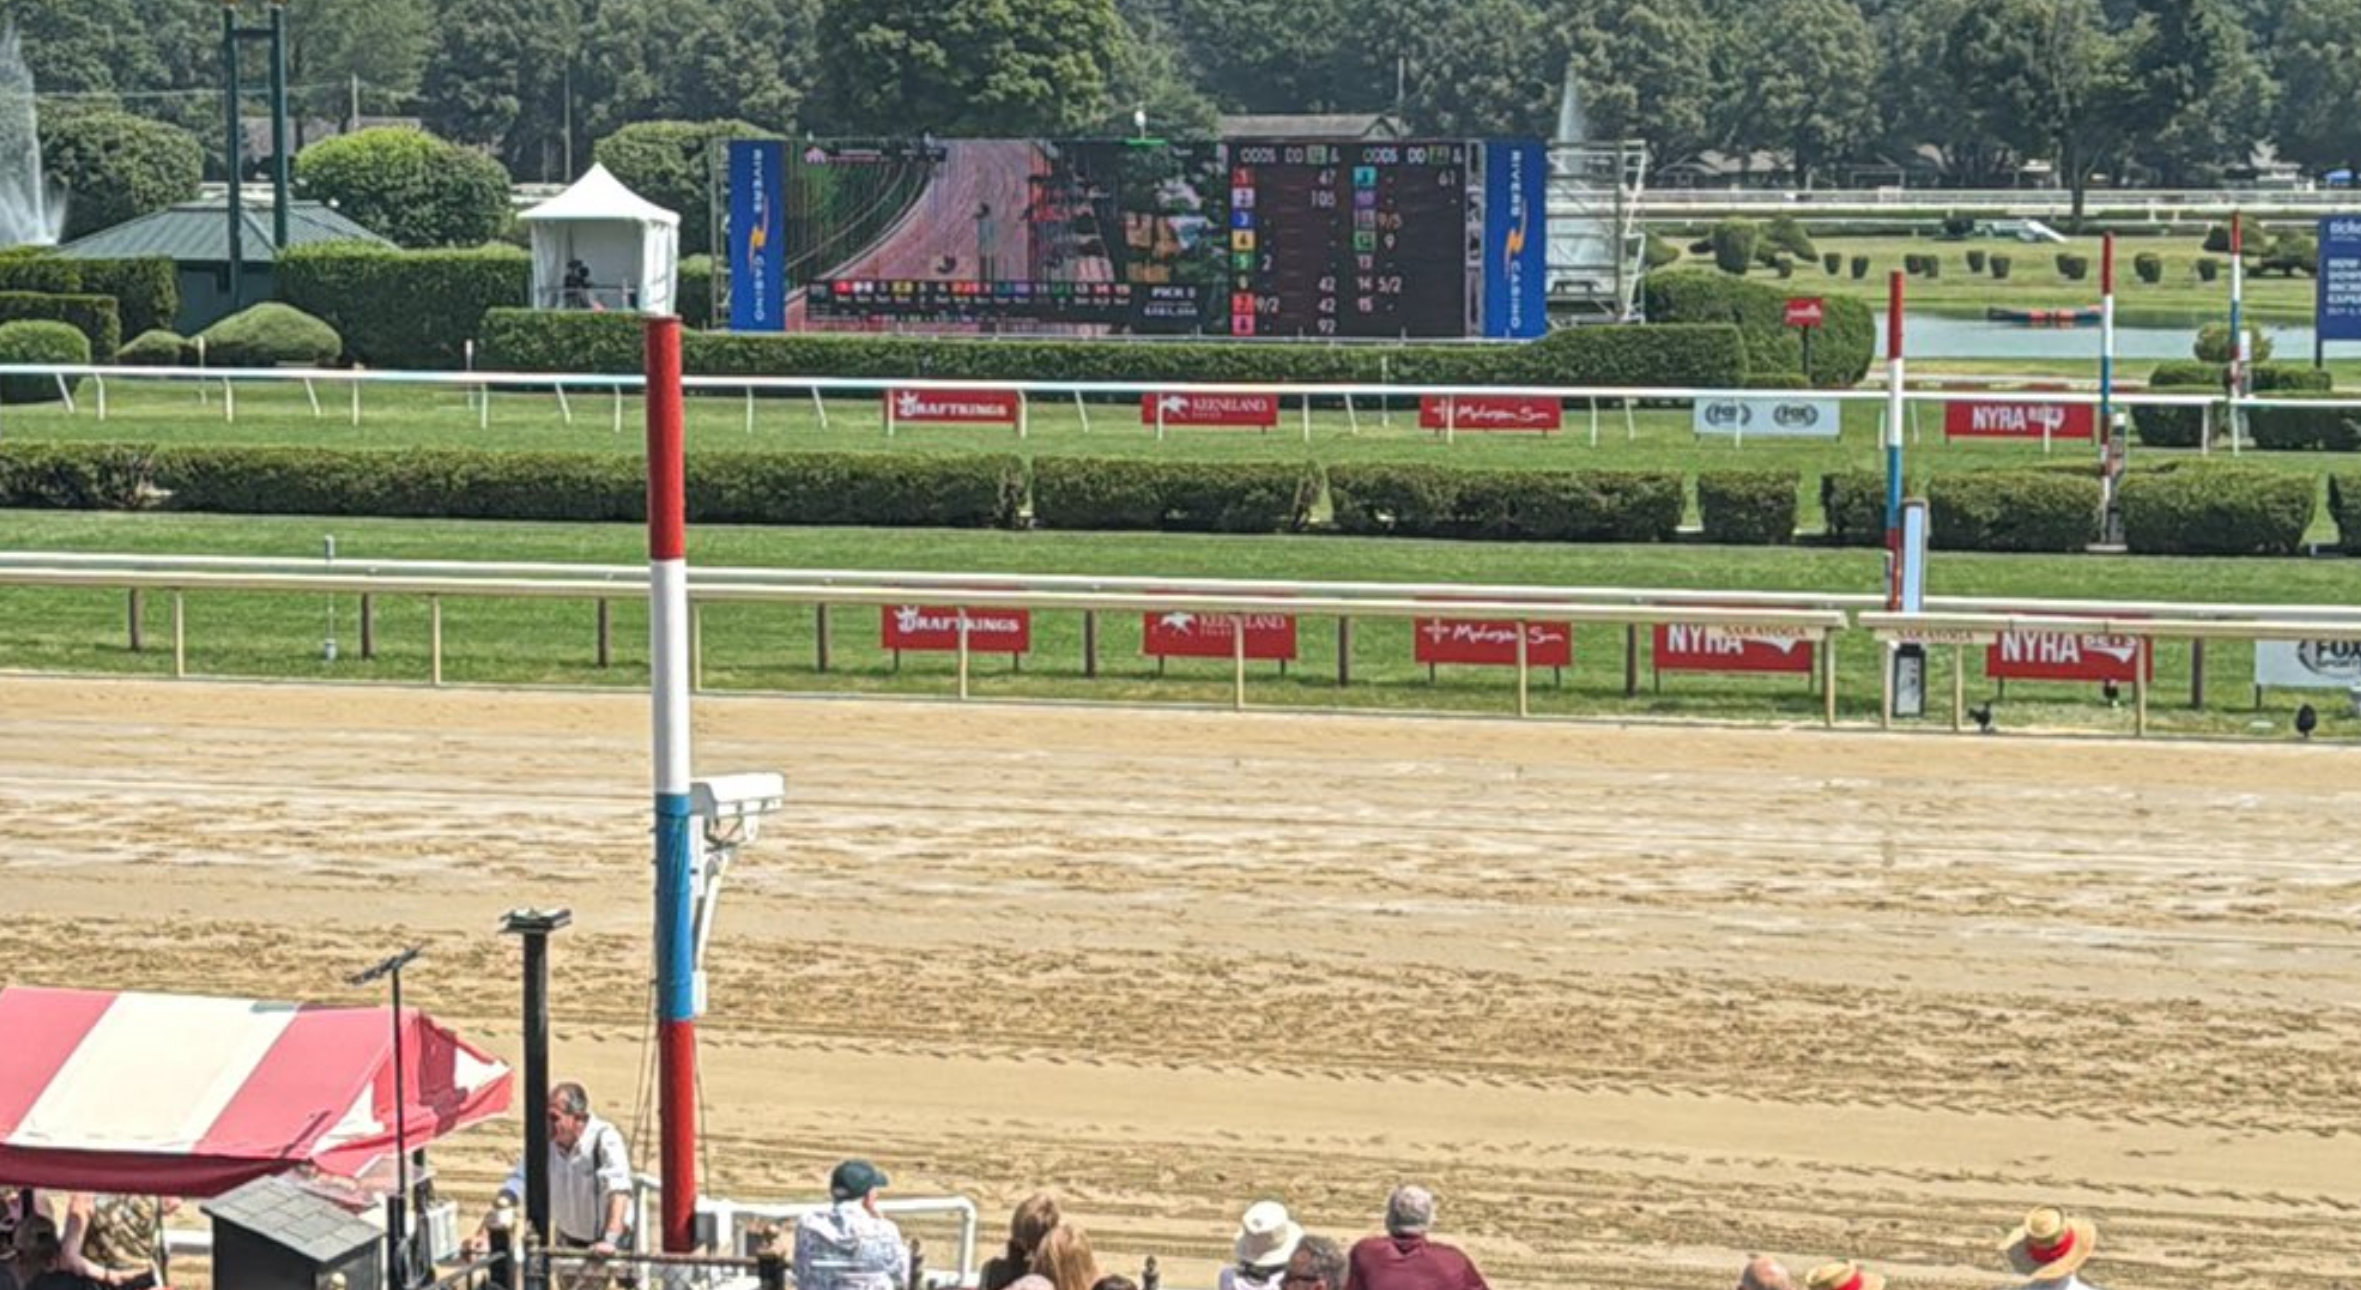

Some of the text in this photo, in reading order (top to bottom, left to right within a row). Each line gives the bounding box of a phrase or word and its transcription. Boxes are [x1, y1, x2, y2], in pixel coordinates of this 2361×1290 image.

[1318, 169, 1336, 186] 47
[752, 149, 766, 321] RIVERS CASINO
[1238, 232, 1248, 247] 4
[1510, 149, 1522, 329] RIVERS CASINO
[1262, 254, 1272, 271] 2
[1318, 276, 1336, 293] 42
[1378, 276, 1402, 294] 5/2
[1318, 297, 1336, 314] 42
[1317, 318, 1336, 335] 92
[1973, 405, 2027, 431] NYRA
[1200, 613, 1286, 629] KEELAND
